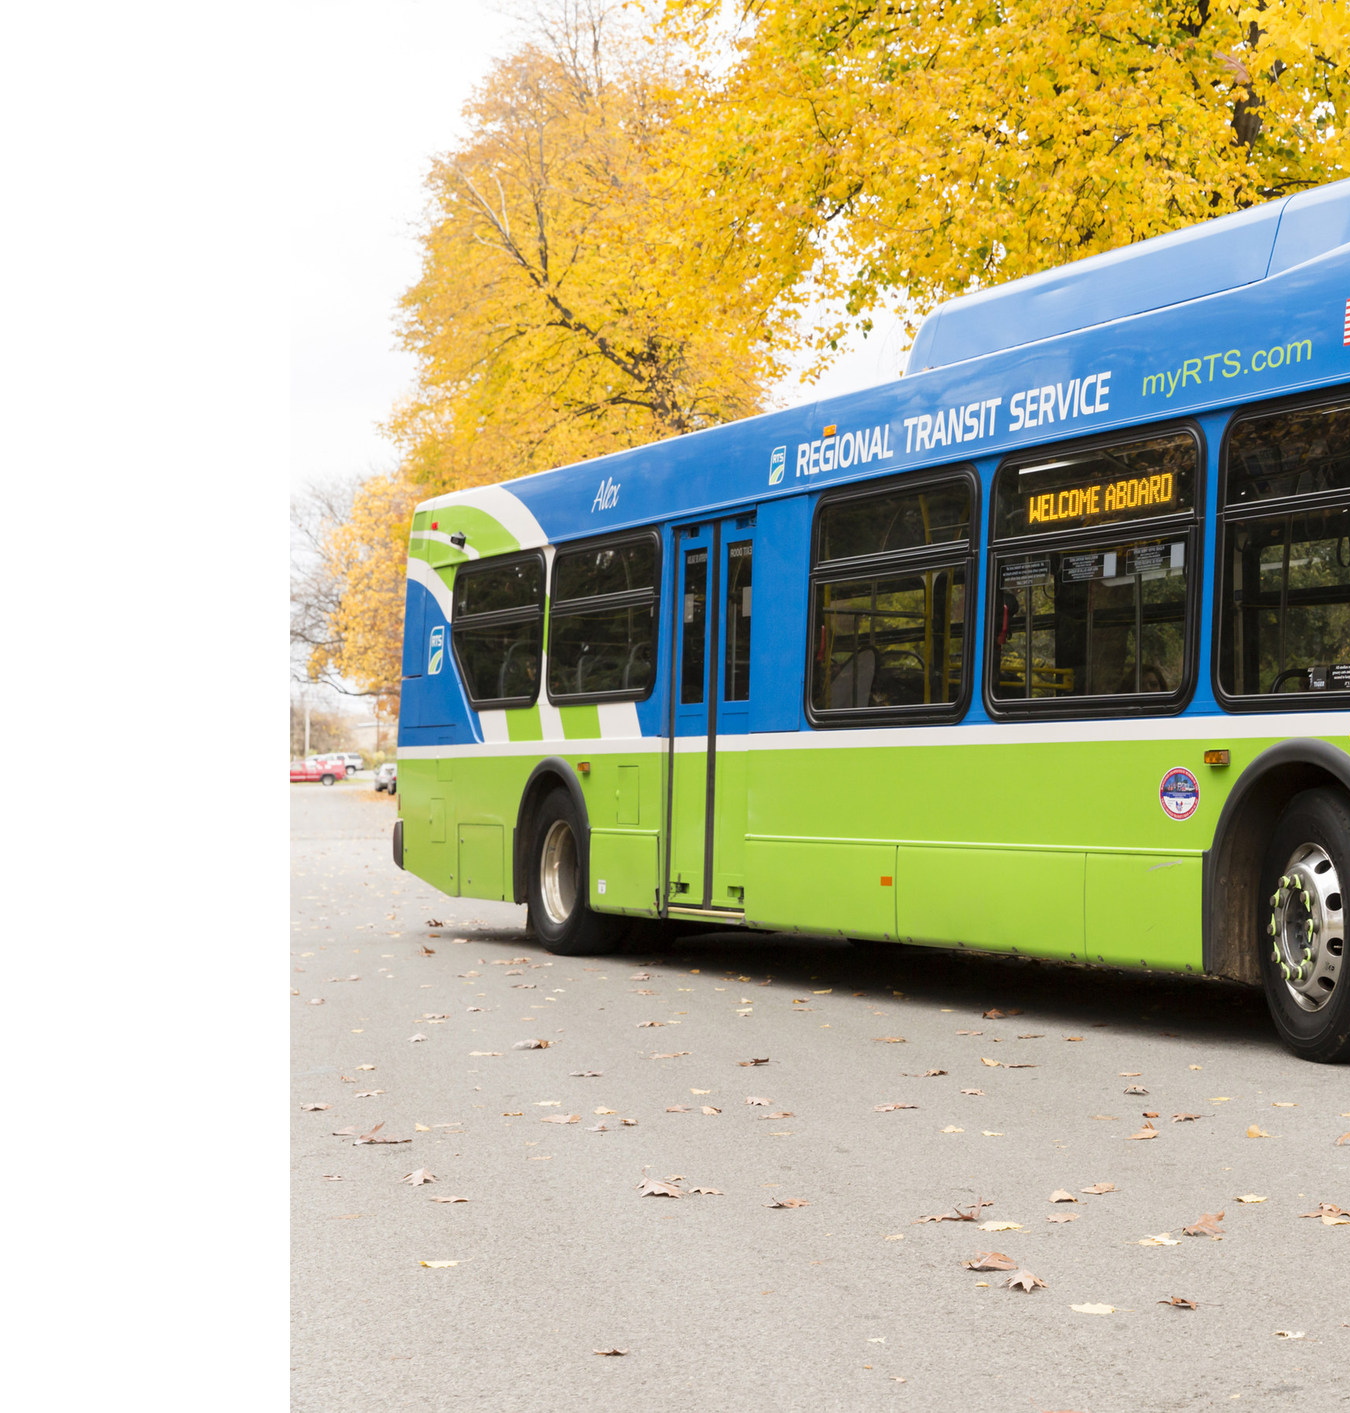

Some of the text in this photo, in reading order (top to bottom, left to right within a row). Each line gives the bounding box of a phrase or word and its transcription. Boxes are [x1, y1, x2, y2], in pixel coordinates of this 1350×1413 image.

[1142, 338, 1313, 399] myRTS.com
[796, 370, 1112, 478] REGIONAL TRANSIT SERVICE
[590, 475, 622, 513] Alex
[1028, 472, 1174, 524] WELCOME ABOARD
